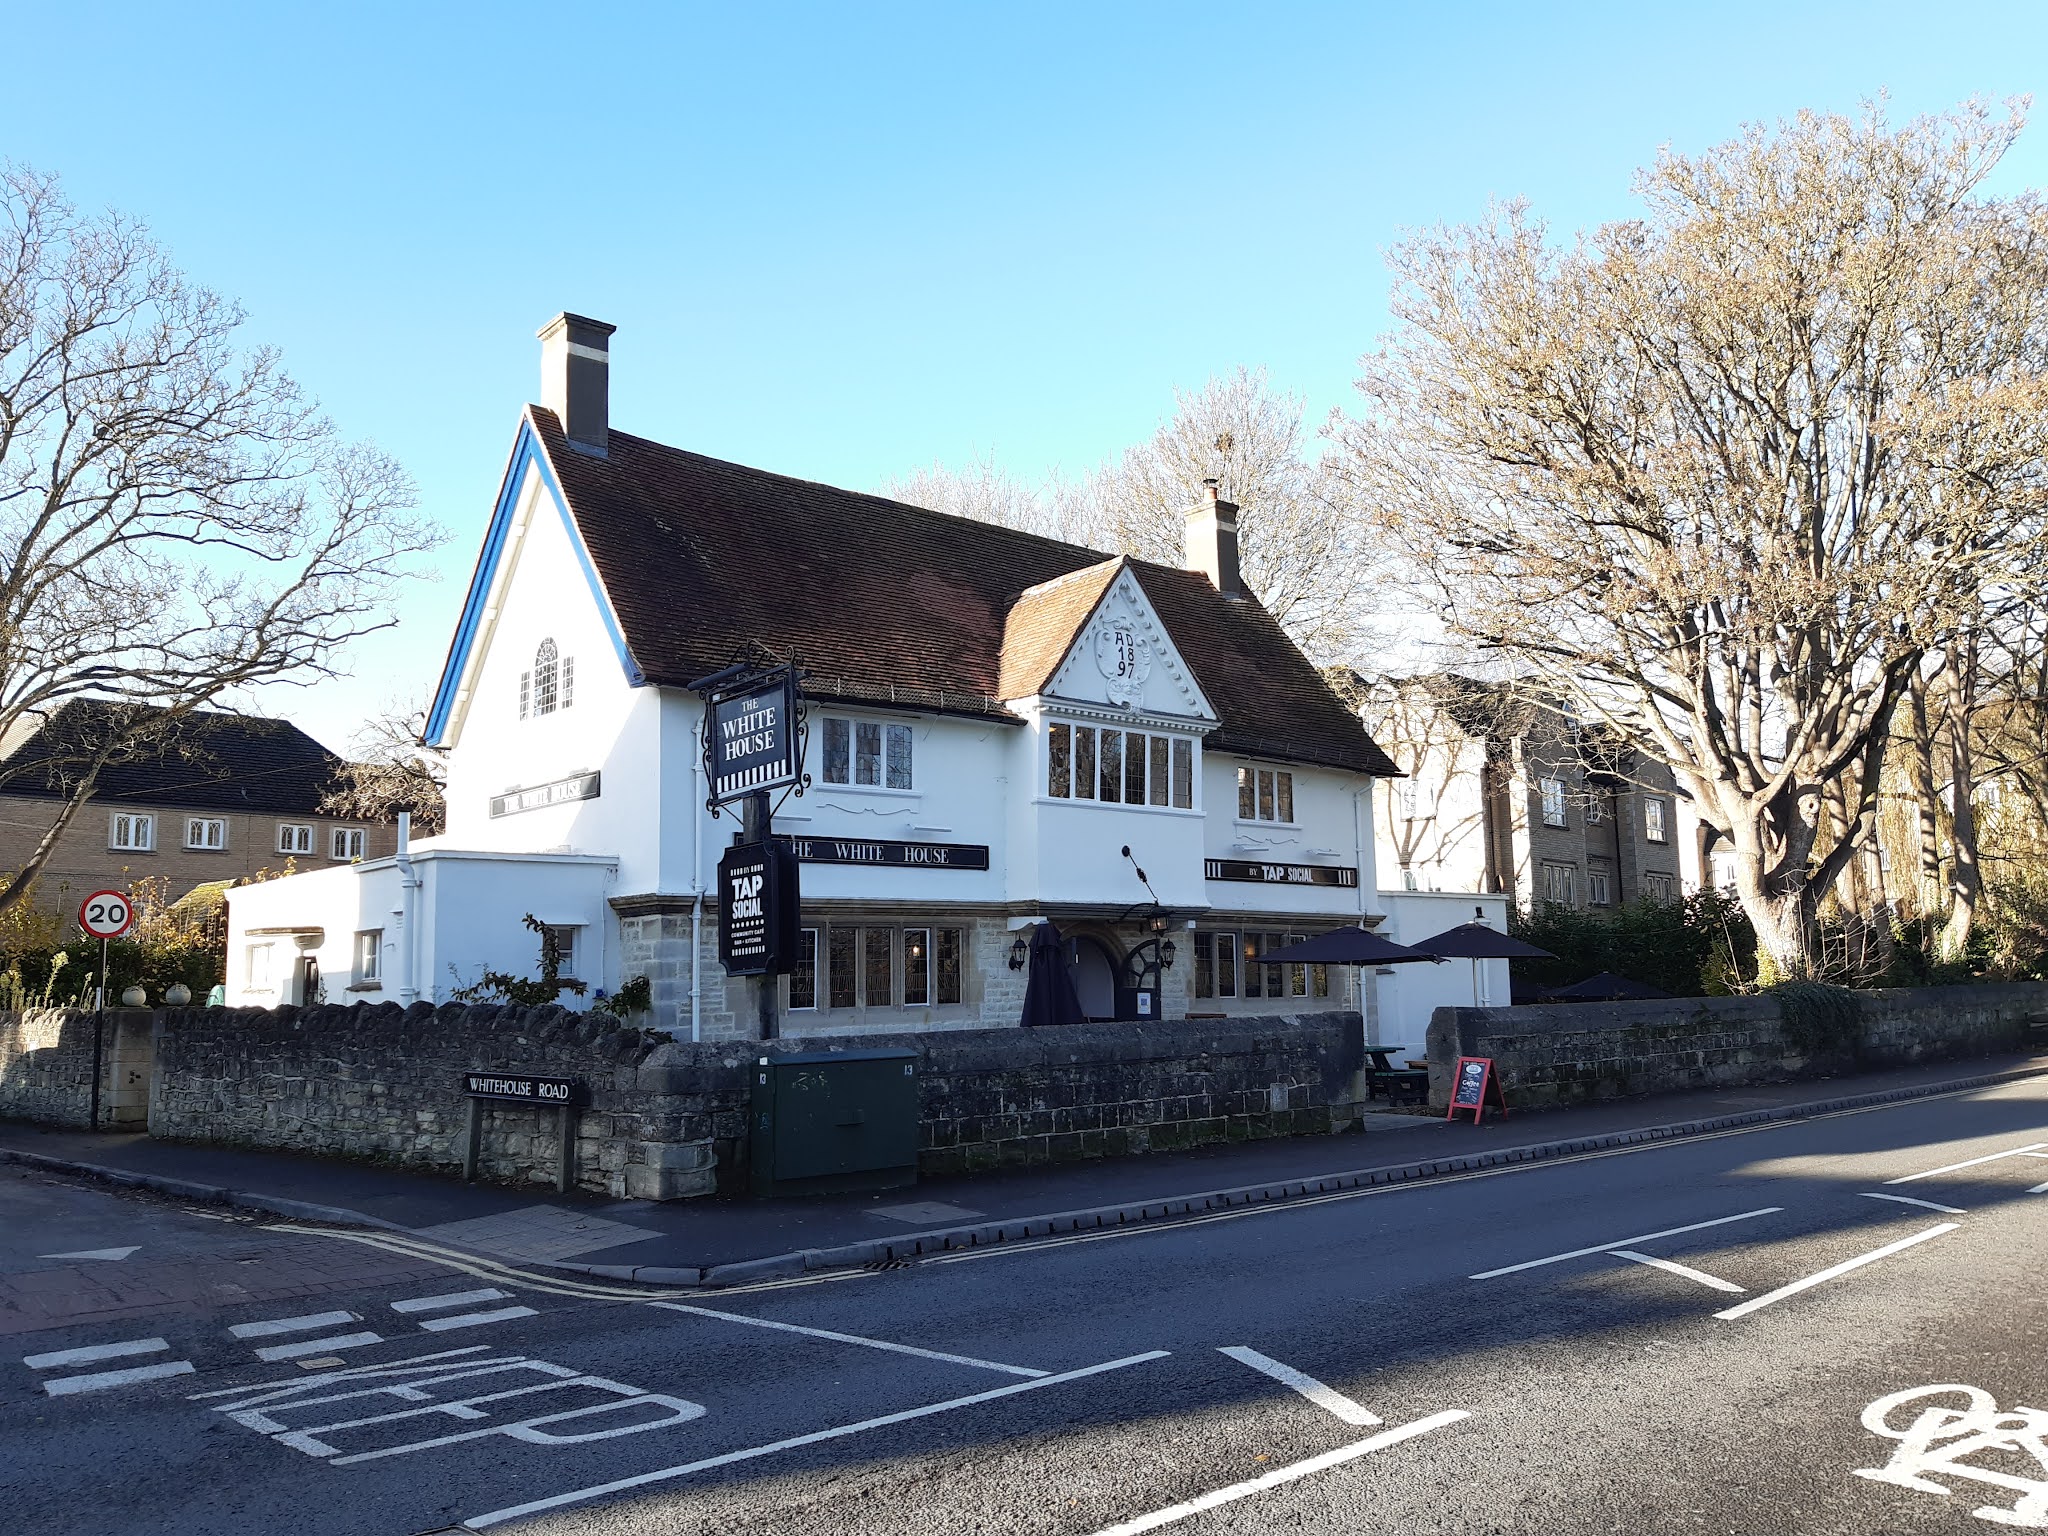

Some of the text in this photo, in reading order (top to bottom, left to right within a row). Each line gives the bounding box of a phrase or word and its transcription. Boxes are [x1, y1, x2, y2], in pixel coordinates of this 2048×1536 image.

[742, 698, 759, 712] THE
[722, 707, 776, 739] WHITE
[725, 730, 775, 761] HOUSE
[790, 841, 949, 864] HE WHITE HOUSE
[1249, 865, 1313, 882] BY TAP SOCIAL
[731, 874, 764, 901] TAP
[89, 904, 125, 924] 20
[732, 897, 763, 920] SOCIAL
[904, 1064, 913, 1076] 13
[469, 1077, 569, 1099] WHITEHOUSE ROAD
[185, 1345, 707, 1465] KEEP
